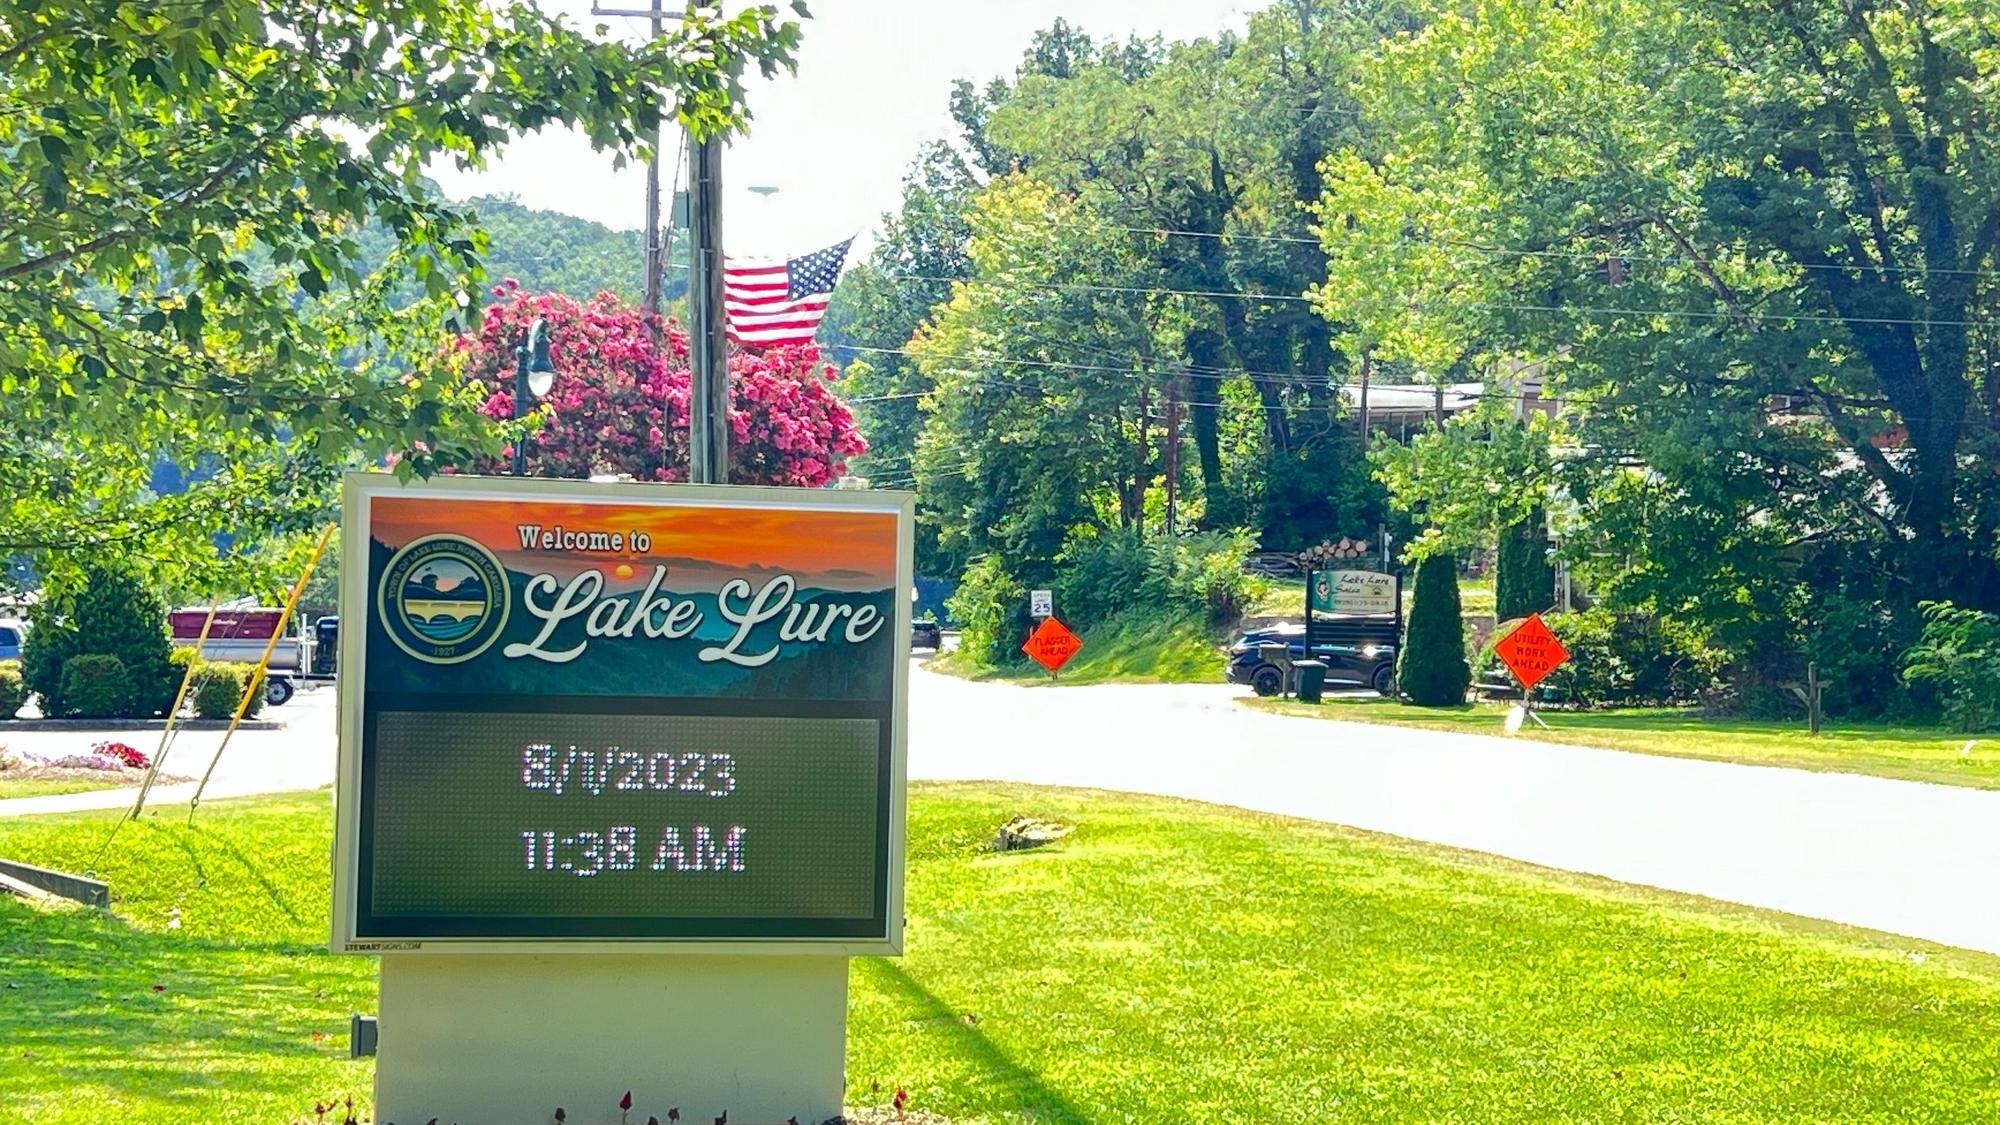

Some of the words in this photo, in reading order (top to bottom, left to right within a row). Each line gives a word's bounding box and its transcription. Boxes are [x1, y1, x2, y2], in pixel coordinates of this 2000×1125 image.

[517, 524, 622, 552] Welcome
[629, 529, 651, 553] to
[1339, 573, 1364, 584] Lake
[503, 563, 703, 663] Lake
[698, 574, 885, 666] Lure
[1034, 603, 1050, 613] 25
[1514, 633, 1551, 646] UTILITY
[1516, 646, 1547, 658] WORK
[1512, 659, 1549, 671] AHEAD
[522, 743, 737, 797] 8/1/2023
[521, 825, 637, 877] 11:38
[650, 825, 747, 872] AM
